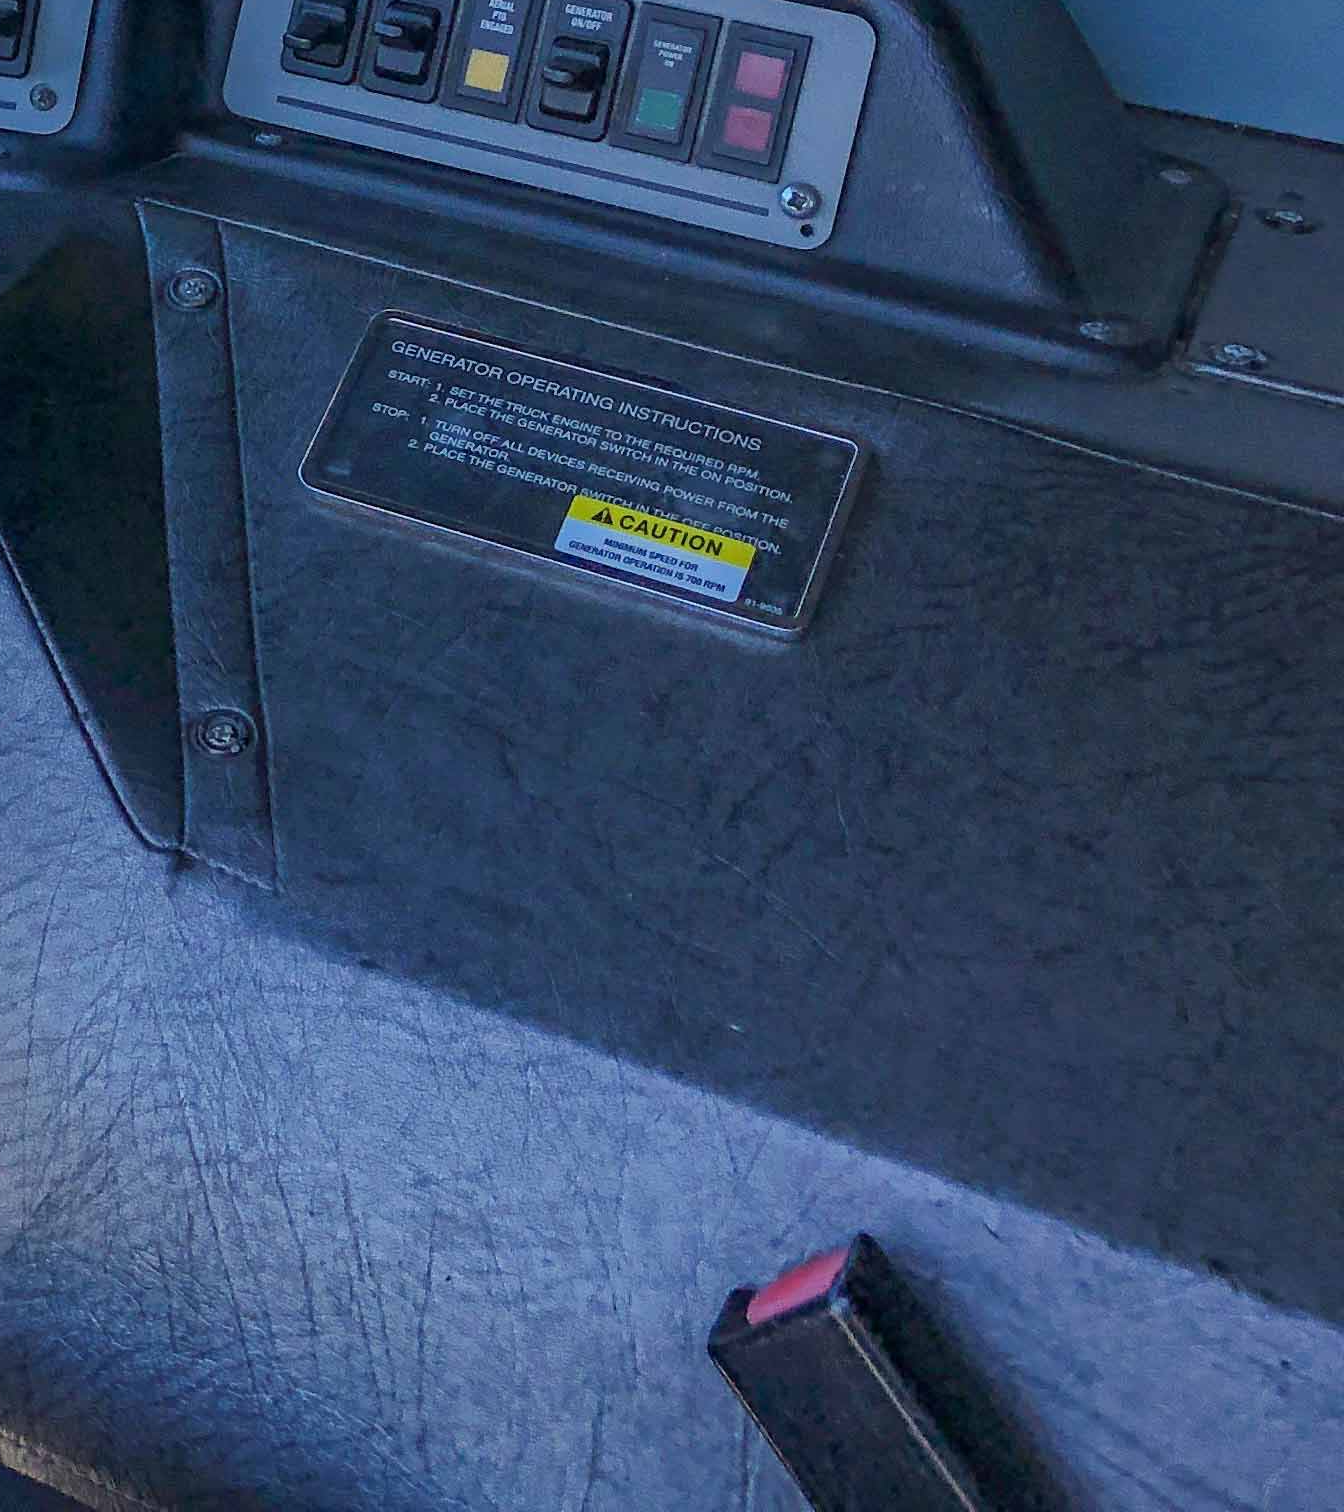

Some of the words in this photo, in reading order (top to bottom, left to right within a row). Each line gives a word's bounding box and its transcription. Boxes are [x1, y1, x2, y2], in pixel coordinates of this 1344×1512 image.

[480, 19, 514, 35] ENGAGED
[491, 10, 507, 21] PTO
[565, 4, 613, 22] GENERATOR
[570, 18, 603, 31] ON/OFF
[391, 340, 504, 380] GENERATOR
[506, 371, 614, 411] OPERATING
[618, 402, 763, 451] INSTRUCTIONS
[387, 369, 432, 389] START:
[449, 386, 477, 401] SET
[478, 393, 505, 409] THE
[505, 399, 552, 421] TRUCK
[552, 414, 603, 438] ENGINE
[604, 428, 622, 441] TO
[625, 434, 651, 450] THE
[653, 443, 725, 470] REQUIRED
[726, 463, 761, 482] RPM.
[429, 430, 512, 462] GENERATOR.
[371, 402, 410, 421] STOP:
[435, 419, 472, 439] TURN
[472, 431, 501, 446] OFF
[501, 439, 525, 454] ALL
[527, 445, 586, 471] DEVICES
[587, 462, 661, 493] RECEIVING
[663, 484, 716, 508] POWER
[717, 500, 760, 521] FROM
[761, 512, 791, 529] THE
[444, 398, 487, 418] PLACE
[488, 409, 514, 425] THE
[517, 418, 598, 449] GENERATOR
[599, 439, 653, 463] SWITCH
[655, 454, 670, 468] IN
[672, 460, 699, 477] THE
[700, 470, 722, 484] ON
[724, 475, 793, 504] POSITION.
[424, 442, 466, 464] PLACE
[469, 455, 496, 471] THE
[496, 463, 578, 494] GENERATOR
[581, 488, 633, 509] SWITCH
[635, 503, 650, 514] IN
[653, 508, 681, 523] THE
[603, 538, 647, 558] MINIMUM
[649, 550, 678, 566] SPEED
[679, 560, 699, 573] FOR
[620, 514, 723, 556] CAUTION
[568, 540, 622, 563] GENERATOR
[622, 556, 674, 577] OPERATION
[674, 571, 683, 580] IS
[685, 574, 703, 586] 700
[703, 580, 726, 593] RPM
